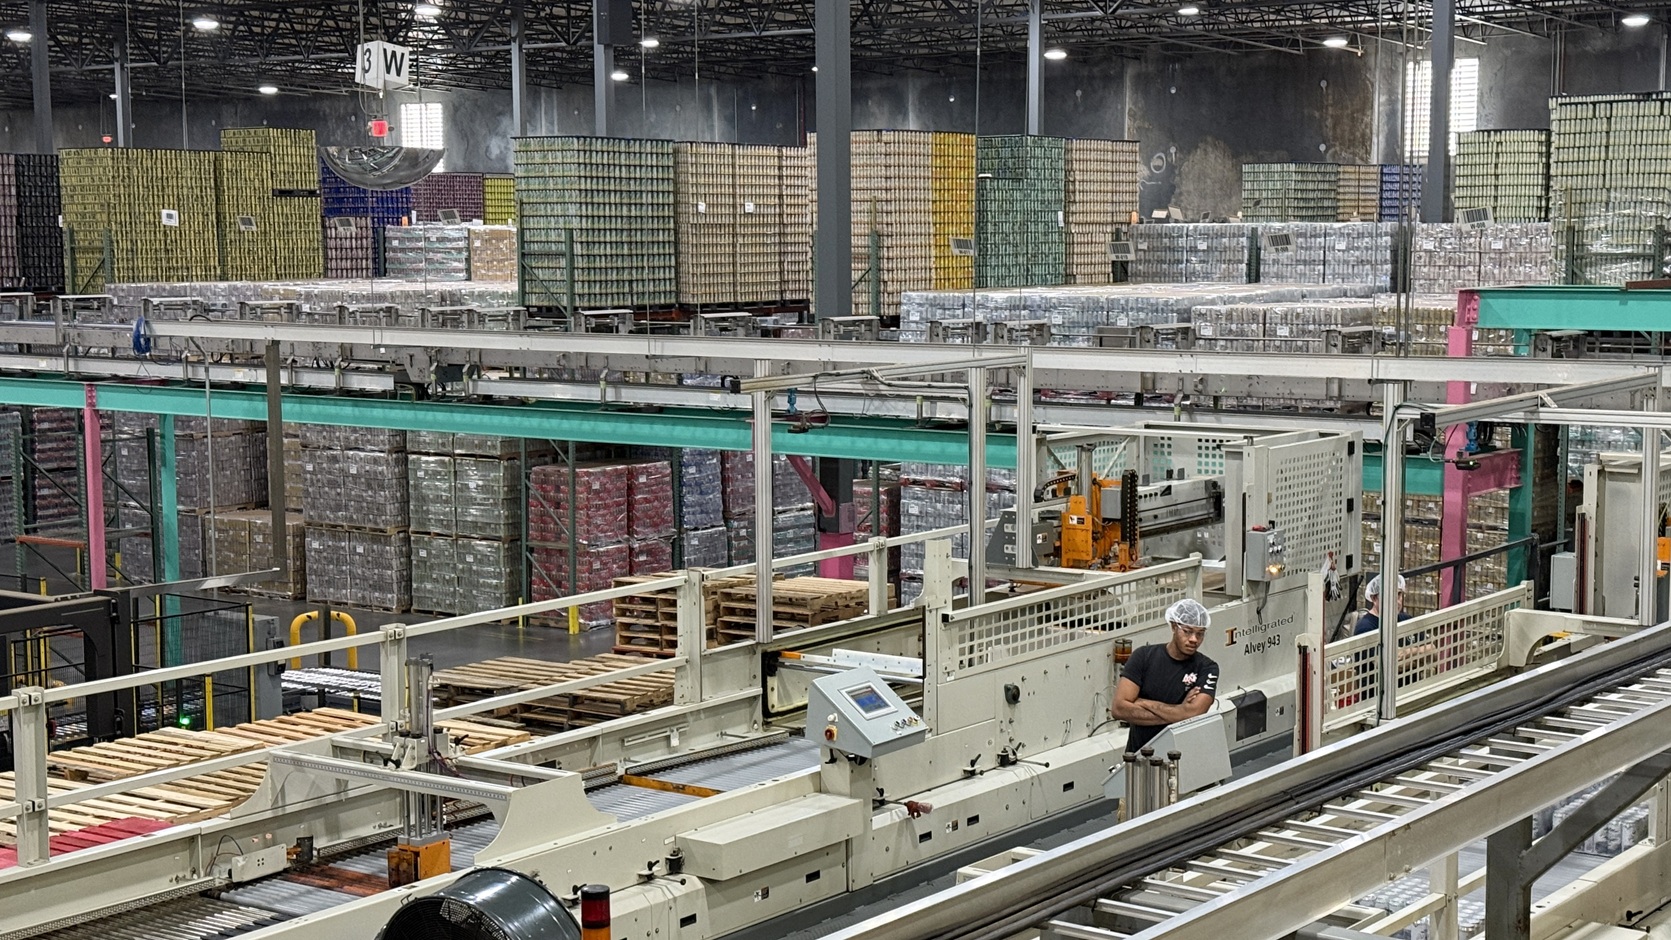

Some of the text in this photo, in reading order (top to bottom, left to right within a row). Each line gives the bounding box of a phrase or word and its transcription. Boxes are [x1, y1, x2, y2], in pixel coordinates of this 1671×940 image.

[363, 48, 371, 74] 3
[383, 47, 405, 77] W
[1225, 614, 1294, 647] Intelligrated
[1243, 634, 1281, 656] Alvey 943
